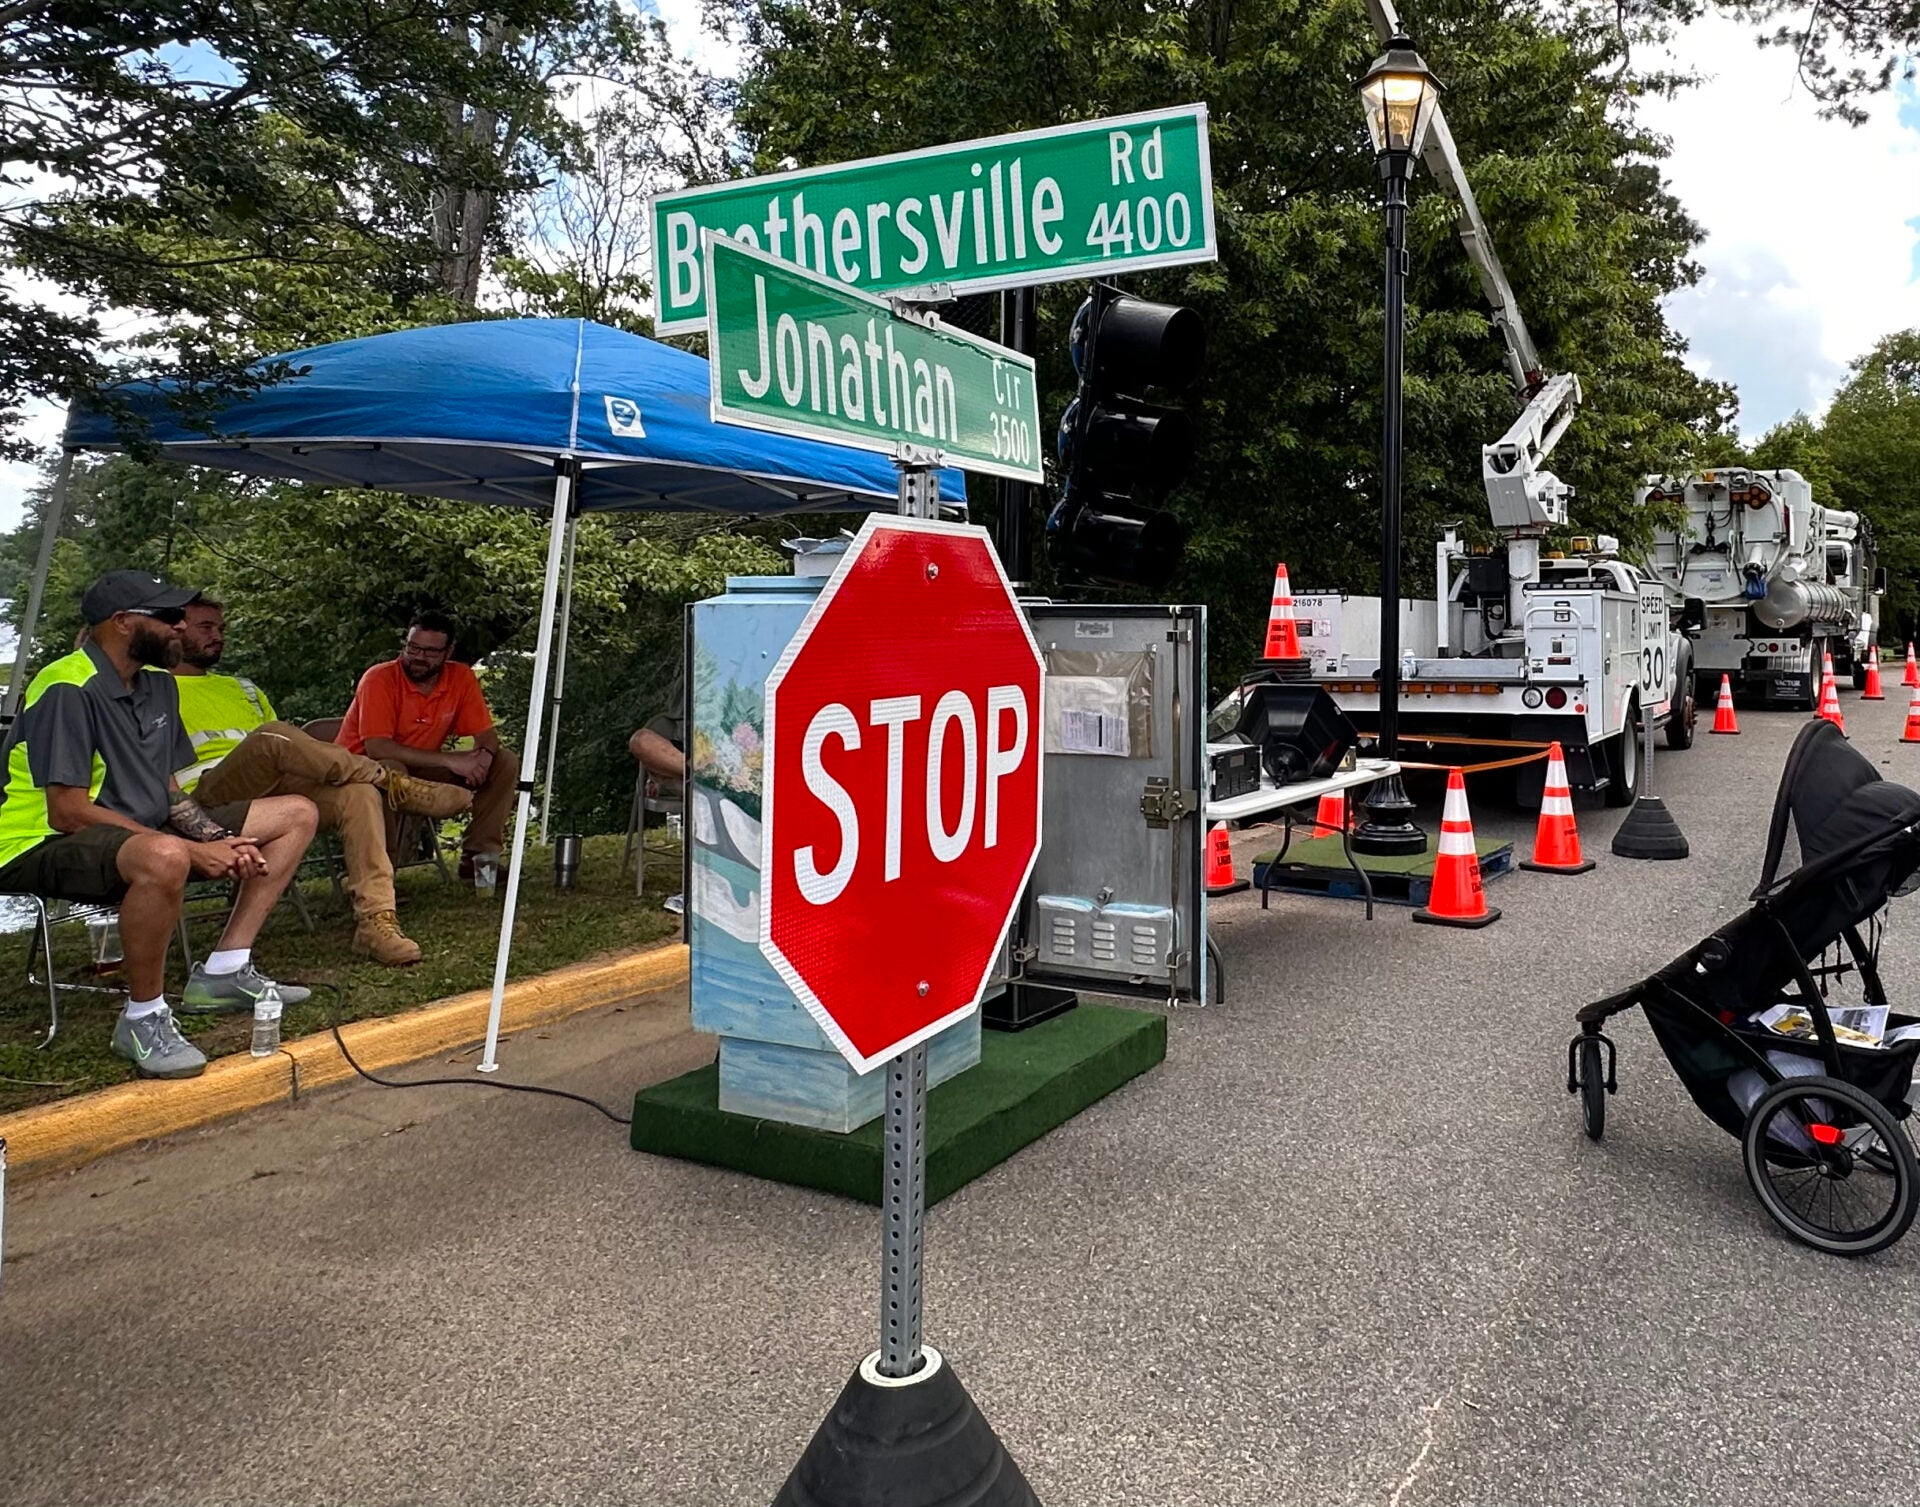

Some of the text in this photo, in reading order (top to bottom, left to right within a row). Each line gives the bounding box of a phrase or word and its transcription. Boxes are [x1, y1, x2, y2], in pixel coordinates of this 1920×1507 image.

[667, 126, 1164, 308] Bthersville Rd
[1086, 192, 1192, 257] 4400
[738, 274, 1021, 443] Jonathan Cir
[990, 411, 1030, 466] 3500
[1641, 596, 1663, 614] SPEED
[1644, 622, 1662, 640] LIMIT
[1642, 647, 1664, 691] 30
[793, 684, 1029, 906] STOP
